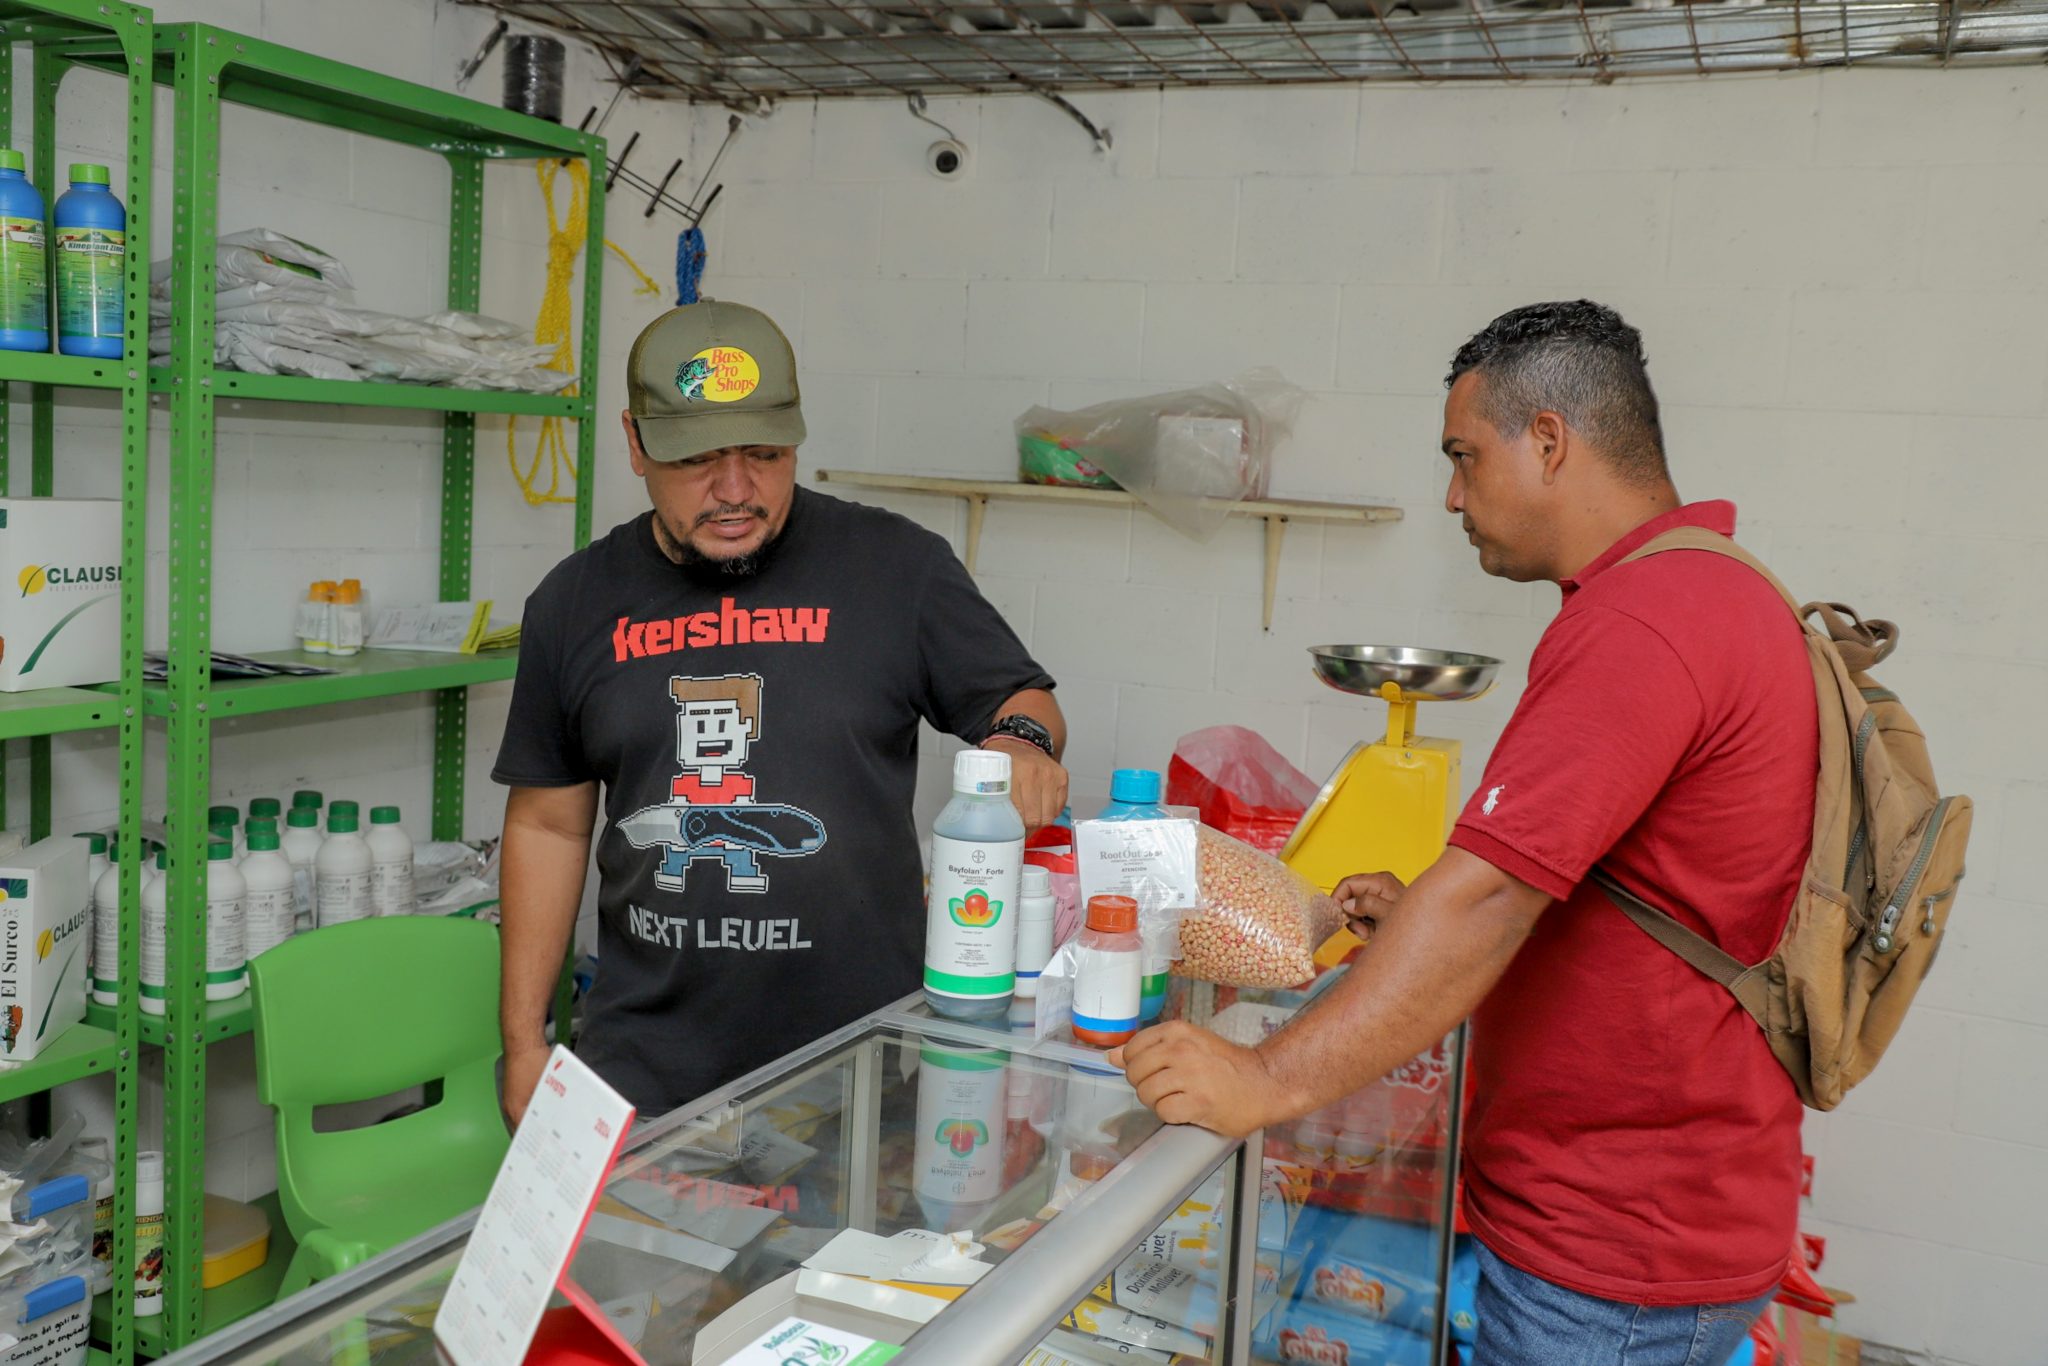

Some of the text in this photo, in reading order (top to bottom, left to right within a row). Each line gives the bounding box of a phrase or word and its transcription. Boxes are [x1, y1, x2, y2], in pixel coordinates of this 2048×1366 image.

[711, 349, 745, 364] Bass
[714, 364, 738, 378] Pro
[715, 377, 756, 394] Shops
[612, 597, 830, 663] kershaw
[53, 909, 86, 943] CLAUS
[628, 904, 812, 951] NEXT LEVEL
[1, 920, 18, 998] El Surco
